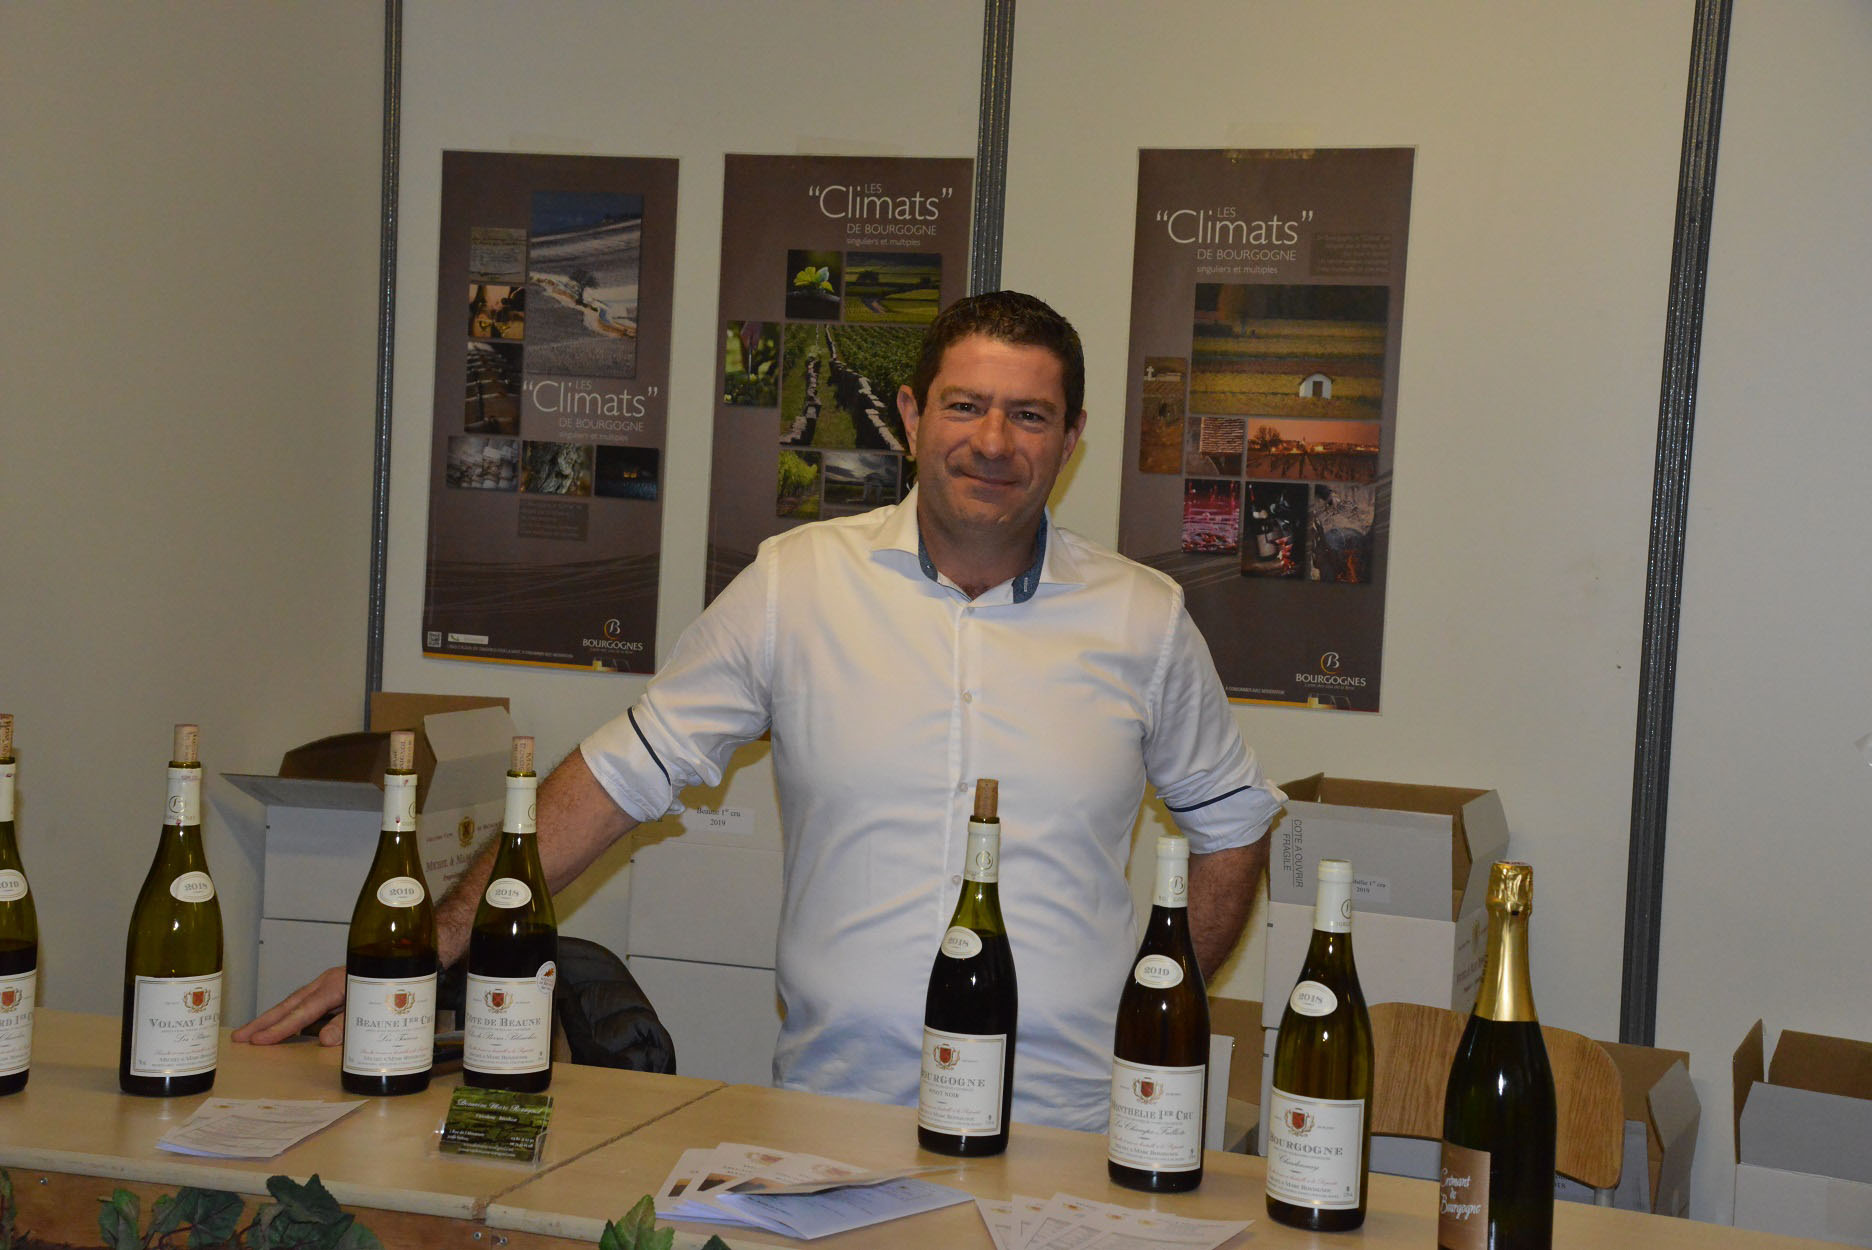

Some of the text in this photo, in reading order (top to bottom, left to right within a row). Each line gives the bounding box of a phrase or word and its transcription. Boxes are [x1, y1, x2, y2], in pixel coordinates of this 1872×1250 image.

[864, 183, 882, 194] LES
[1217, 206, 1236, 218] LES
[847, 223, 937, 236] DE BOURGOGNE
[1197, 248, 1297, 262] DE BOURGOGNE
[1233, 265, 1242, 274] et
[559, 417, 645, 432] DE BOURGOGNE
[582, 638, 644, 651] BOURGOGNES
[1295, 673, 1367, 687] BOURGOGNES
[1294, 819, 1303, 844] COTE
[1282, 833, 1292, 871] FRAGILE
[1294, 853, 1304, 888] OUVRIR
[389, 888, 415, 896] 2019
[495, 888, 520, 897] 2018
[1144, 966, 1170, 977] 2019
[149, 1018, 196, 1029] VOLNAY
[356, 1016, 400, 1028] BEAUNE
[484, 1017, 497, 1027] DE
[500, 1016, 541, 1027] BEAUNE
[1175, 1110, 1194, 1121] CRU
[1441, 1192, 1482, 1220] Bourgogne
